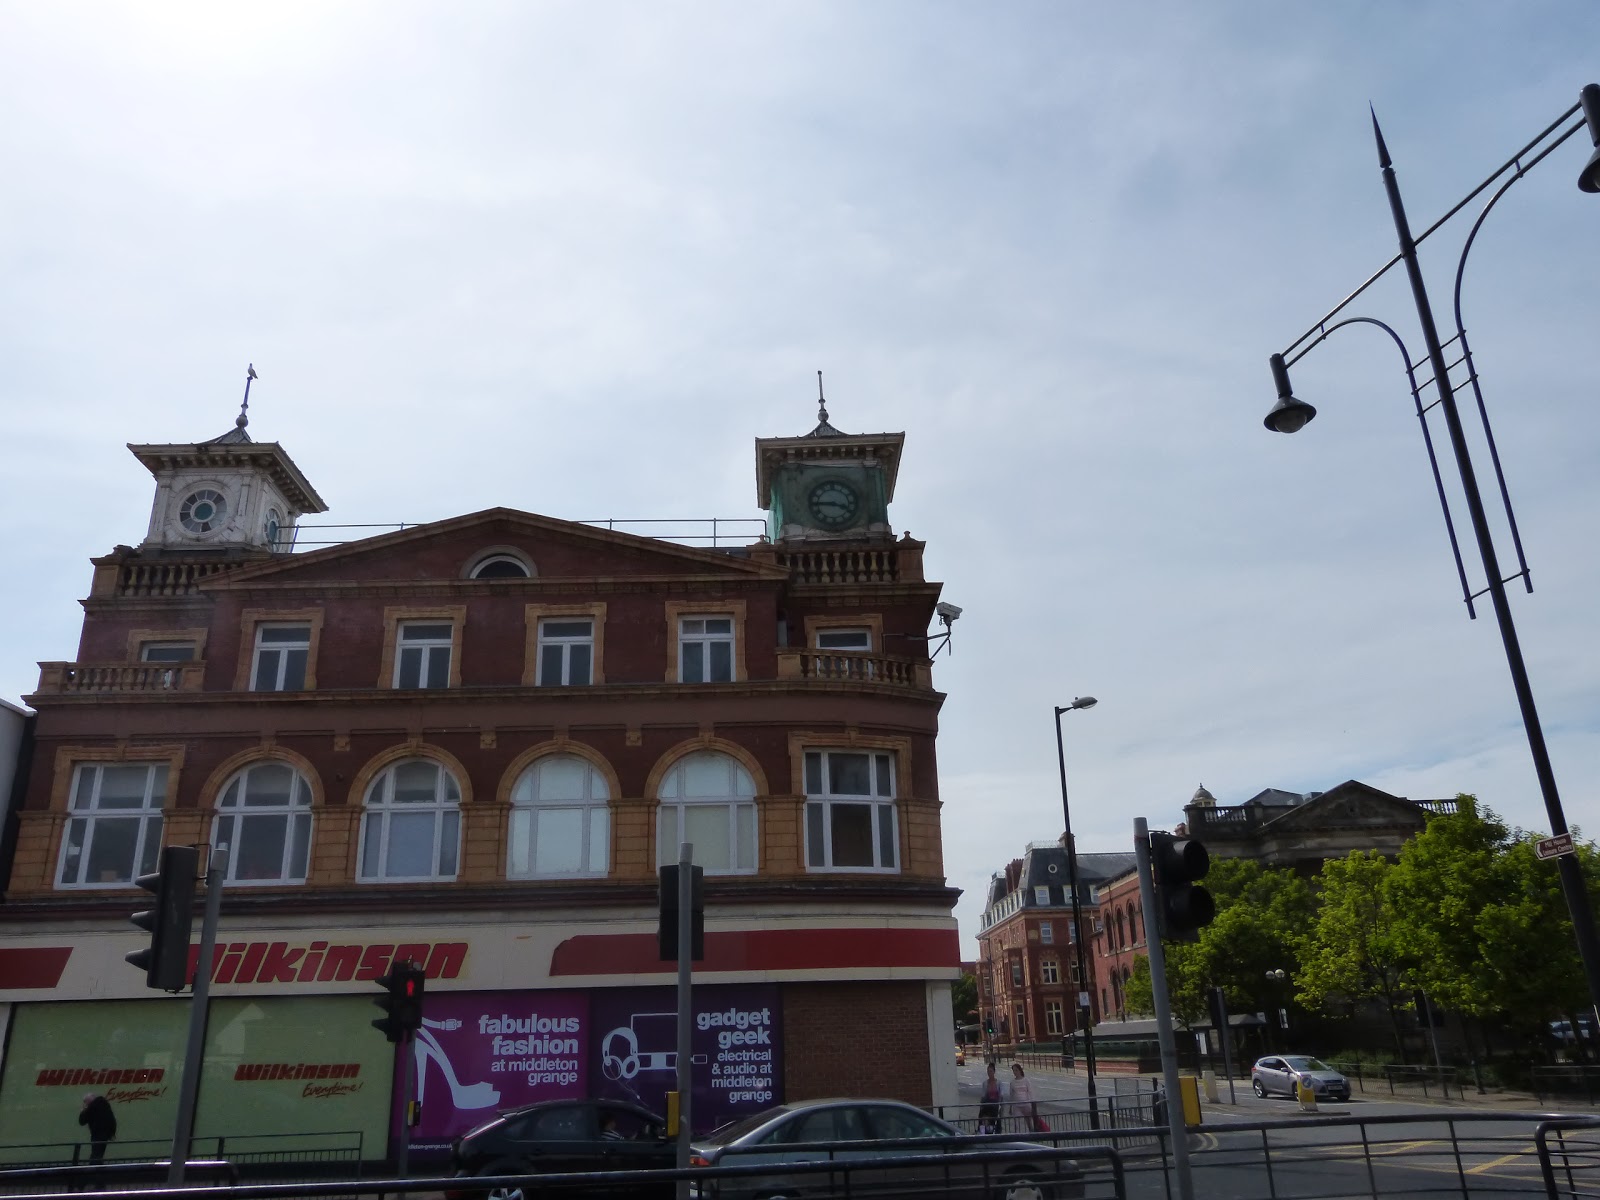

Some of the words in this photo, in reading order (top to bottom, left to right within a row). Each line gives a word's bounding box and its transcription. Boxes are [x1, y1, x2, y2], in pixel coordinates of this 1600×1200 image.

[1553, 838, 1567, 846] House
[478, 1014, 580, 1034] fabulous
[696, 1008, 771, 1031] gadget
[491, 1034, 579, 1055] fashion
[718, 1026, 771, 1050] geek
[717, 1049, 772, 1062] electrical
[491, 1059, 506, 1072] at
[508, 1057, 578, 1072] middleton
[711, 1062, 721, 1075] &
[723, 1062, 758, 1075] audio
[759, 1062, 772, 1074] at
[528, 1072, 578, 1087] grange
[711, 1075, 772, 1088] middleton
[105, 1087, 168, 1103] Everytime!
[302, 1082, 364, 1098] Everytime!
[728, 1091, 773, 1104] grange
